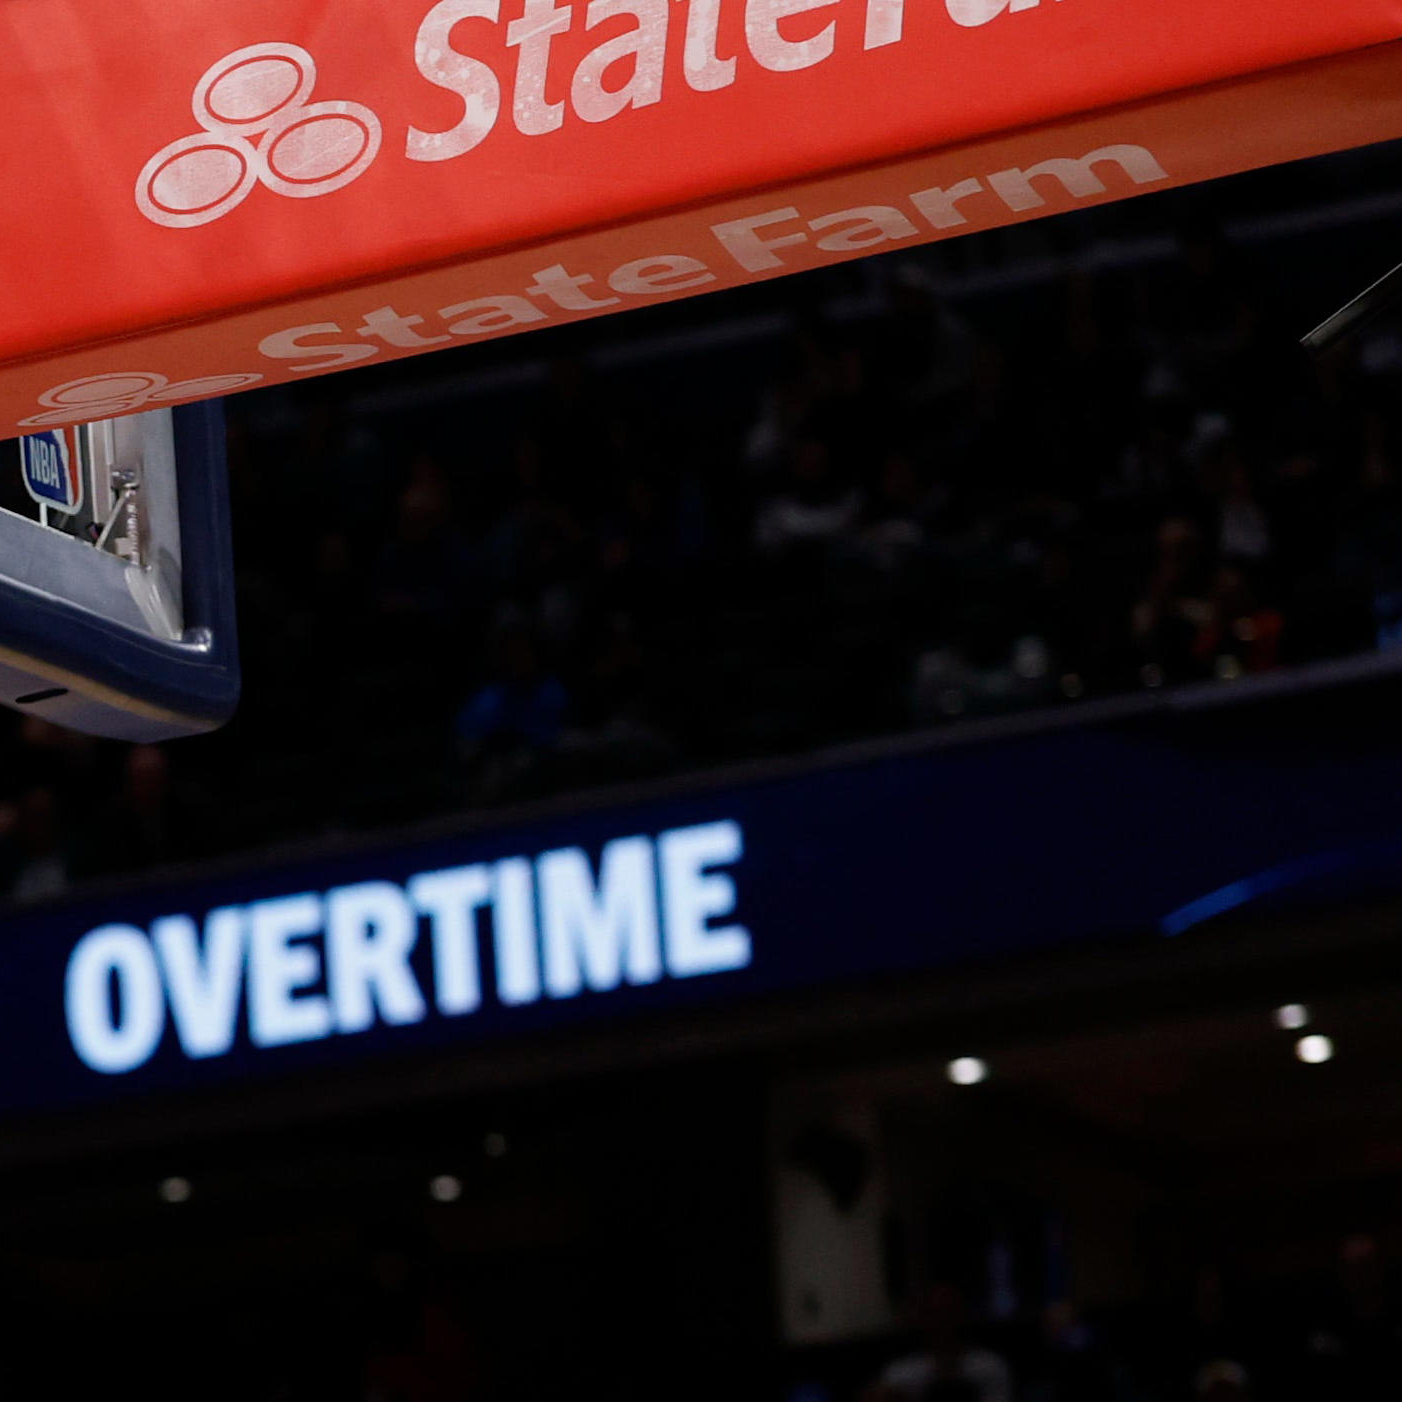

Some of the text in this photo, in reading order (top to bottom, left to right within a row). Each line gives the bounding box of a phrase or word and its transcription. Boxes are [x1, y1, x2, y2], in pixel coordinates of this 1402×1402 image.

[257, 143, 1170, 372] State Farm
[29, 435, 60, 490] NBA
[64, 820, 752, 1074] OVERTIME
